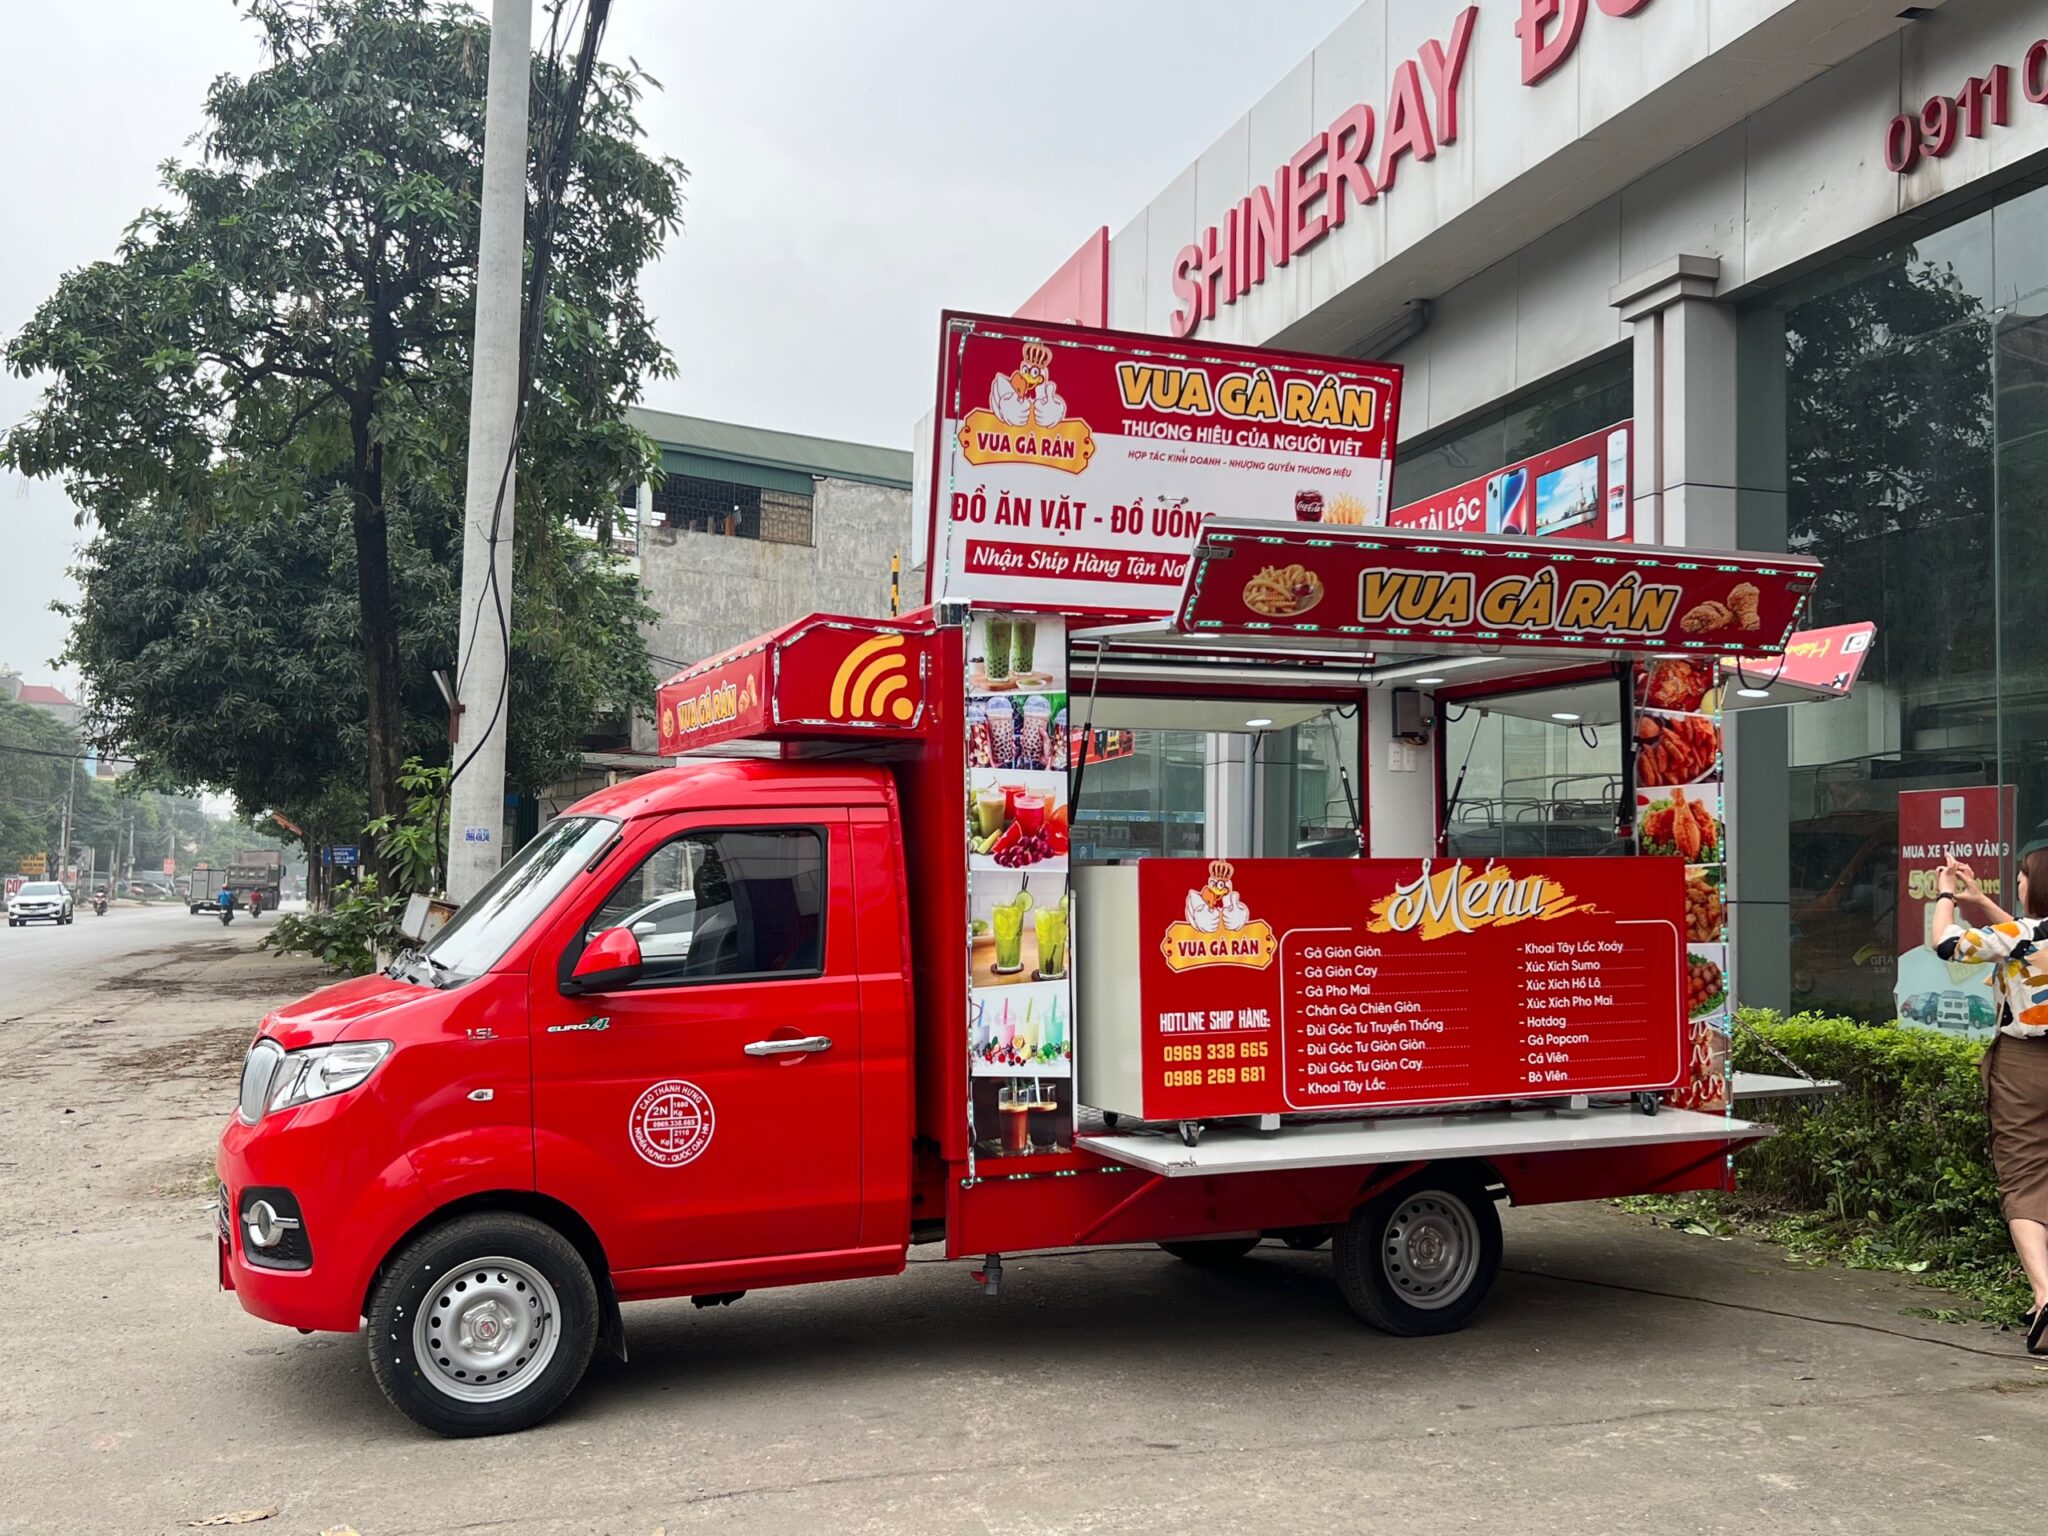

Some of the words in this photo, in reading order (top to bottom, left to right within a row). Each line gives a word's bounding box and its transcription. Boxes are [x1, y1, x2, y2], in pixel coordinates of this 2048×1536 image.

[1884, 64, 2009, 174] 0911
[1170, 6, 1477, 337] SHINERAY
[1117, 363, 1212, 413] VUA
[1216, 369, 1278, 420] GÀ
[1282, 376, 1376, 429] RÁN
[978, 432, 1011, 453] VUA
[1015, 433, 1037, 455] GÀ
[1041, 436, 1075, 458] RÁN
[1122, 420, 1192, 440] THƯƠNG
[1236, 427, 1269, 448] CỦA
[1273, 433, 1325, 454] NGƯỜI
[1128, 450, 1147, 461] HỢP
[1149, 450, 1166, 461] TÁC
[1168, 453, 1188, 463] KINH
[1190, 456, 1221, 466] DOANH
[951, 484, 987, 523] ĐỒ
[994, 490, 1032, 527] ĂN
[1041, 494, 1086, 536] VẶT
[1111, 497, 1144, 535] ĐỒ
[1447, 496, 1481, 532] LỘC
[972, 546, 1023, 571] Nhận
[1028, 550, 1069, 575] Ship
[1073, 553, 1121, 578] Hàng
[1127, 557, 1156, 582] Tận
[1160, 560, 1190, 579] Nơ
[1361, 570, 1473, 624] VUA
[1479, 568, 1555, 628] GÀ
[1558, 573, 1679, 633] RÁN
[678, 698, 698, 734] VUA
[698, 686, 714, 728] GÀ
[713, 680, 736, 725] RÁN
[1902, 845, 1925, 858] MUA
[1928, 844, 1941, 858] XE
[1178, 940, 1206, 957] VUA
[1210, 937, 1230, 956] GÀ
[1231, 936, 1259, 955] RÁN
[1304, 946, 1322, 959] Gà
[1325, 945, 1352, 958] Giòn
[1354, 944, 1381, 957] Giòn
[1525, 943, 1555, 954] Khoai
[1557, 942, 1575, 955] Tây
[1598, 940, 1624, 954] Xoáy
[1305, 966, 1323, 978] Gà
[1325, 965, 1352, 977] Giòn
[1354, 965, 1378, 979] Cay
[1525, 961, 1546, 973] Xúc
[1547, 960, 1569, 972] Xích
[1571, 959, 1600, 971] Sumo
[1305, 985, 1323, 997] Gà
[1326, 984, 1348, 997] Pho
[1350, 983, 1371, 996] Mai
[1526, 979, 1546, 991] Xúc
[1548, 978, 1570, 990] Xích
[1588, 977, 1601, 988] Lô
[1305, 1004, 1337, 1017] Chân
[1339, 1003, 1357, 1015] Gà
[1359, 1002, 1392, 1014] Chiên
[1394, 1000, 1421, 1013] Giòn
[1526, 997, 1547, 1009] Xúc
[1548, 996, 1570, 1008] Xích
[1572, 995, 1592, 1007] Pho
[1594, 994, 1613, 1006] Mai
[1160, 1012, 1206, 1032] HOTLINE
[1209, 1009, 1234, 1031] SHIP
[1238, 1006, 1271, 1029] HÀNG:
[1527, 1015, 1567, 1029] Hotdog
[1306, 1023, 1326, 1036] Đùi
[1328, 1022, 1352, 1035] Góc
[1354, 1021, 1368, 1034] Tư
[1307, 1043, 1327, 1056] Đùi
[1329, 1042, 1353, 1055] Góc
[1355, 1040, 1368, 1053] Tư
[1370, 1040, 1397, 1052] Giòn
[1399, 1038, 1426, 1051] Giòn
[1527, 1034, 1544, 1046] Gà
[1546, 1033, 1589, 1047] Popcorn
[1164, 1045, 1202, 1062] 0969
[1207, 1043, 1235, 1060] 338
[1240, 1041, 1268, 1058] 665
[1527, 1052, 1544, 1065] Cá
[1545, 1051, 1569, 1063] Viên
[1307, 1062, 1327, 1075] Đùi
[1329, 1061, 1353, 1074] Góc
[1355, 1060, 1369, 1073] Tư
[1371, 1059, 1398, 1071] Giòn
[1400, 1057, 1424, 1072] Cay
[1164, 1069, 1202, 1087] 0986
[1207, 1068, 1236, 1085] 269
[1241, 1065, 1266, 1082] 681
[1528, 1071, 1543, 1083] Bò
[1544, 1070, 1568, 1082] Viên
[1307, 1081, 1340, 1095] Khoai
[1343, 1080, 1363, 1094] Tây
[639, 1094, 654, 1110] CAO
[653, 1083, 681, 1097] THÀNH
[681, 1085, 703, 1104] HƯNG
[652, 1105, 668, 1116] 2N
[645, 1146, 667, 1162] HƯNG
